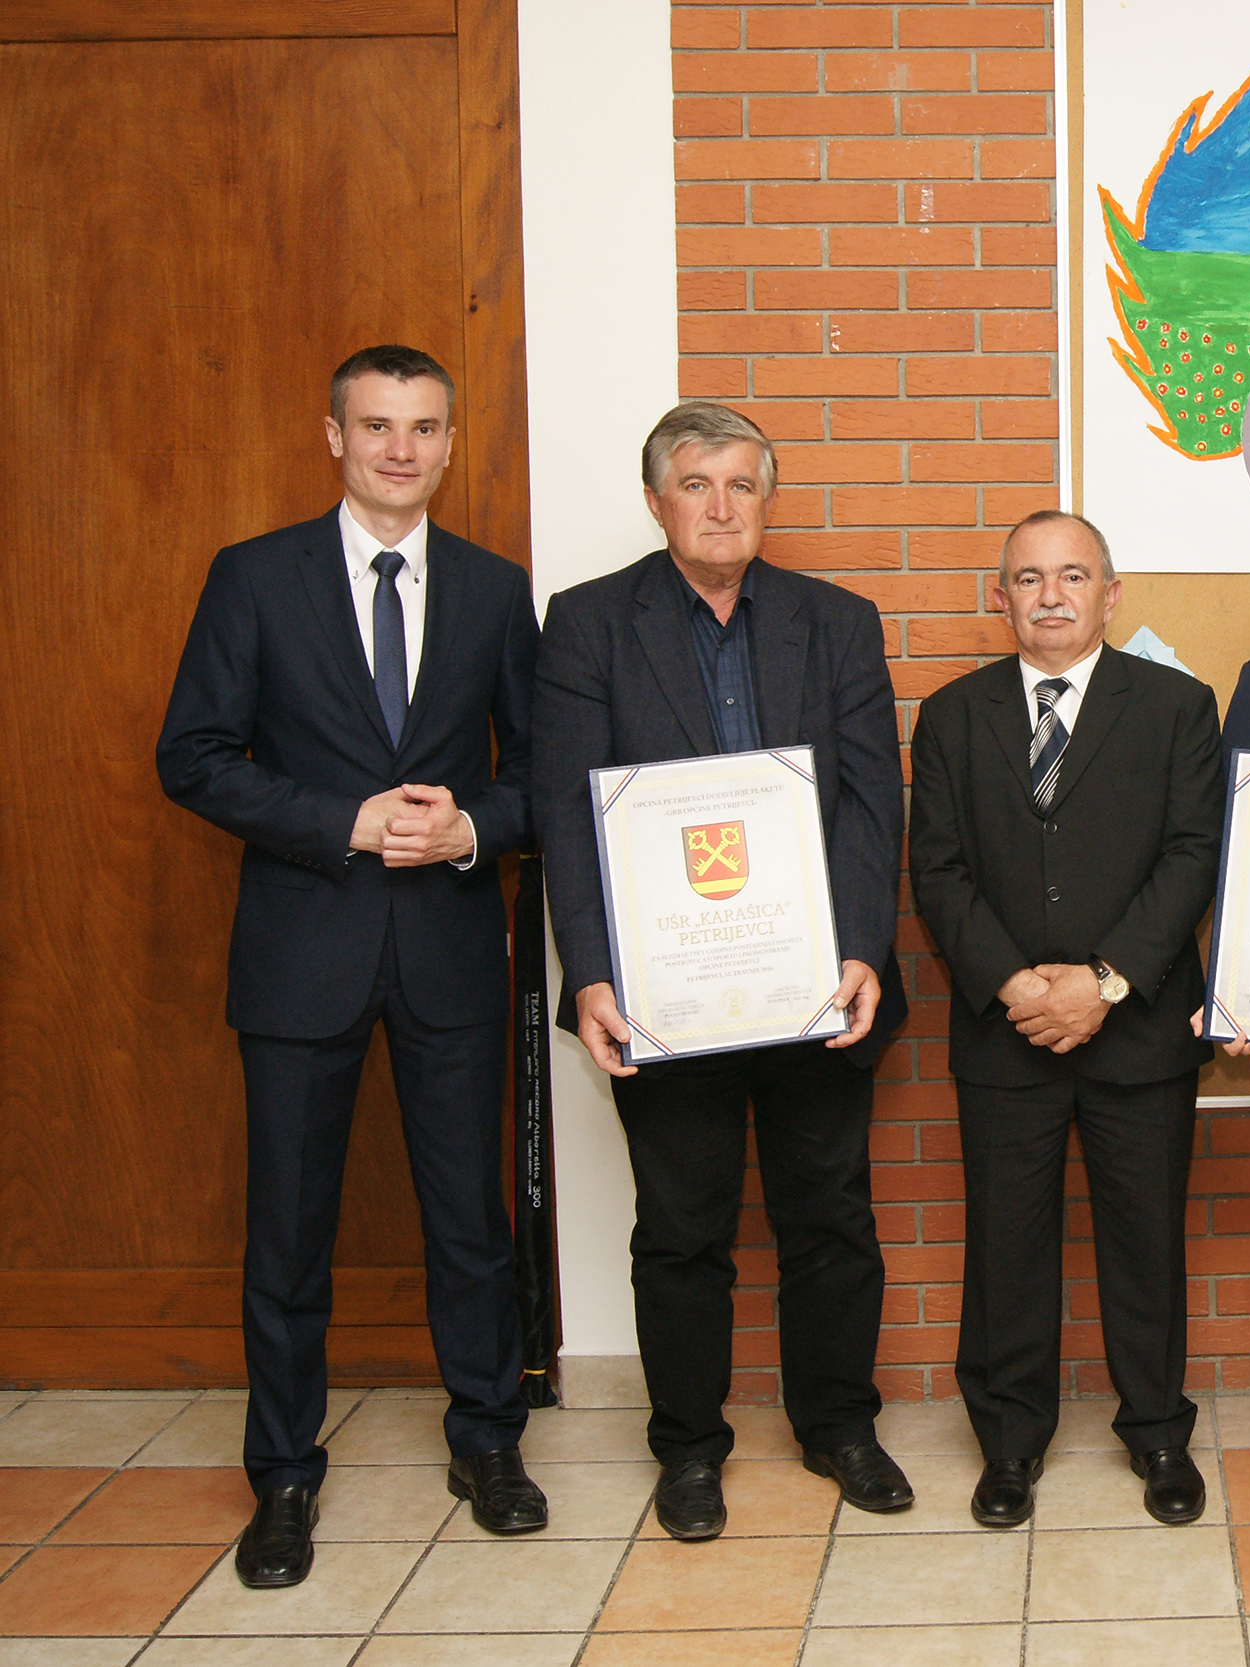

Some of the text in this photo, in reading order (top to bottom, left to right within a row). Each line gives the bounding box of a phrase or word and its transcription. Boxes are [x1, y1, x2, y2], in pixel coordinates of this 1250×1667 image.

[662, 794, 706, 805] PETRIJEVCI
[750, 785, 785, 795] PLAKETU
[656, 913, 691, 932] UŠR
[678, 920, 775, 946] PETRIJEVCI
[531, 991, 540, 1025] TEAM
[532, 1185, 541, 1208] 300
